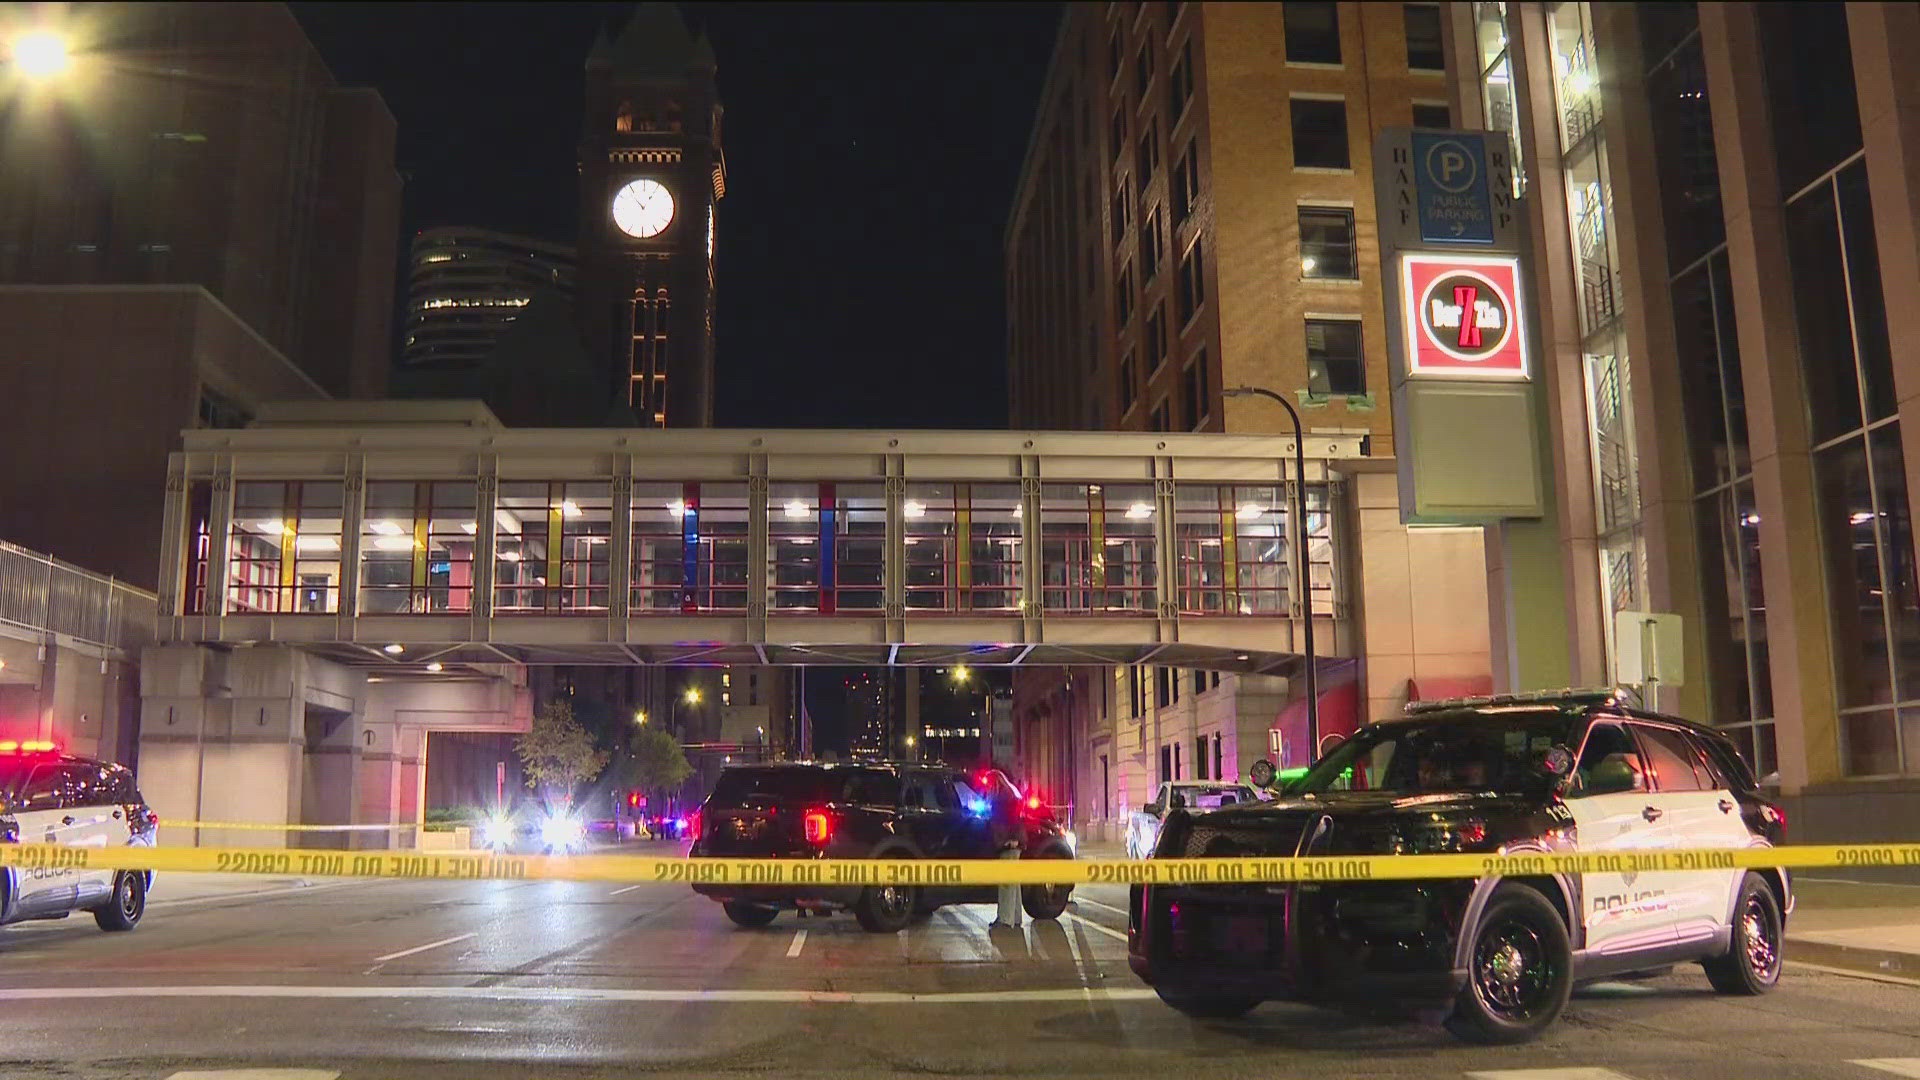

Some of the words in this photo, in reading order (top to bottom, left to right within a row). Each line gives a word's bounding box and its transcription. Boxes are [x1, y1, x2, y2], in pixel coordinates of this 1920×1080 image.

[1393, 147, 1410, 225] HAAF
[1432, 196, 1475, 207] PUBLIC
[1492, 152, 1511, 228] RAMP
[1428, 209, 1484, 221] PARKING
